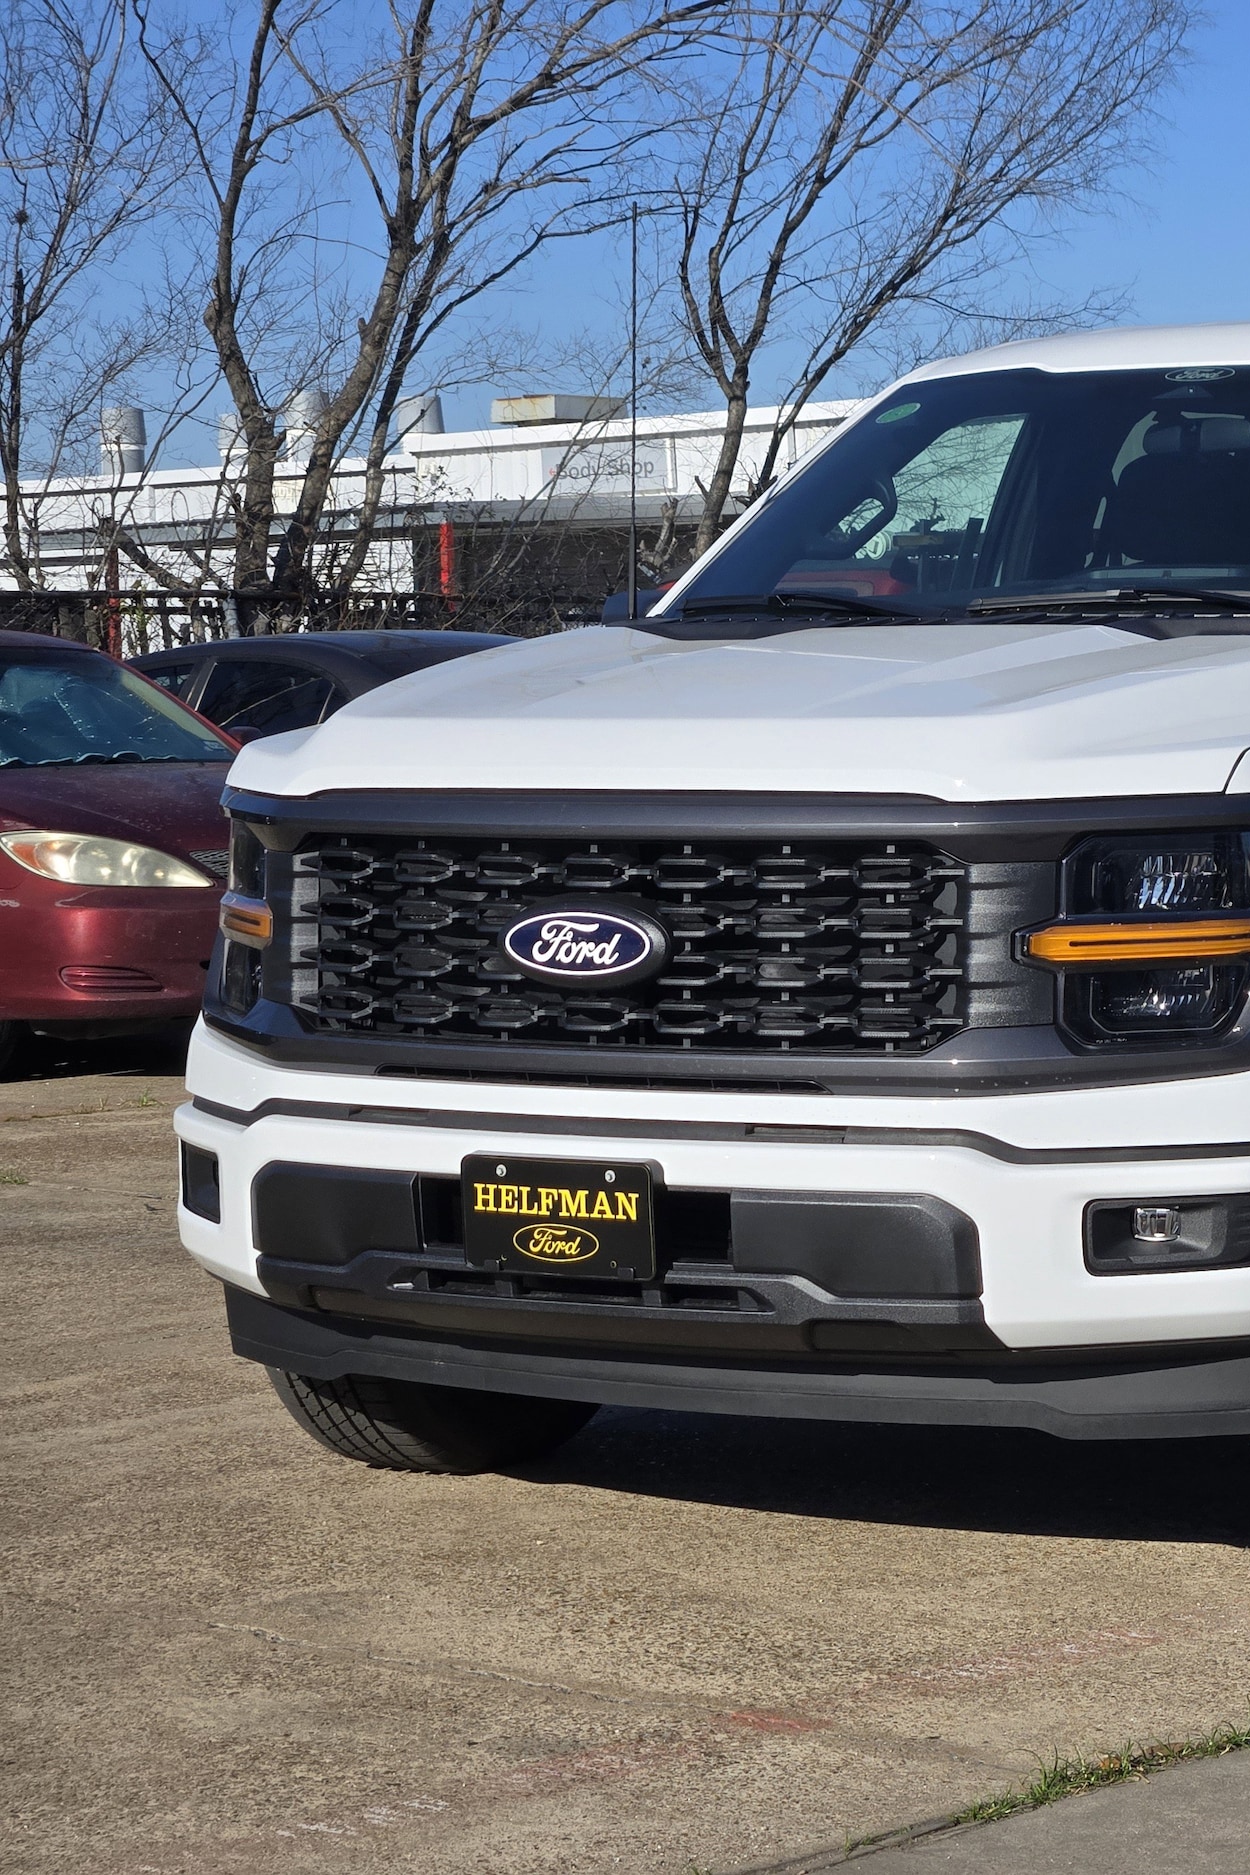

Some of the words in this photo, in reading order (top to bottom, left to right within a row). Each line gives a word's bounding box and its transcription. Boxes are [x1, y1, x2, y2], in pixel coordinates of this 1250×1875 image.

[531, 919, 622, 966] Ford
[473, 1183, 639, 1221] HELFMAN
[529, 1227, 582, 1256] Ford
